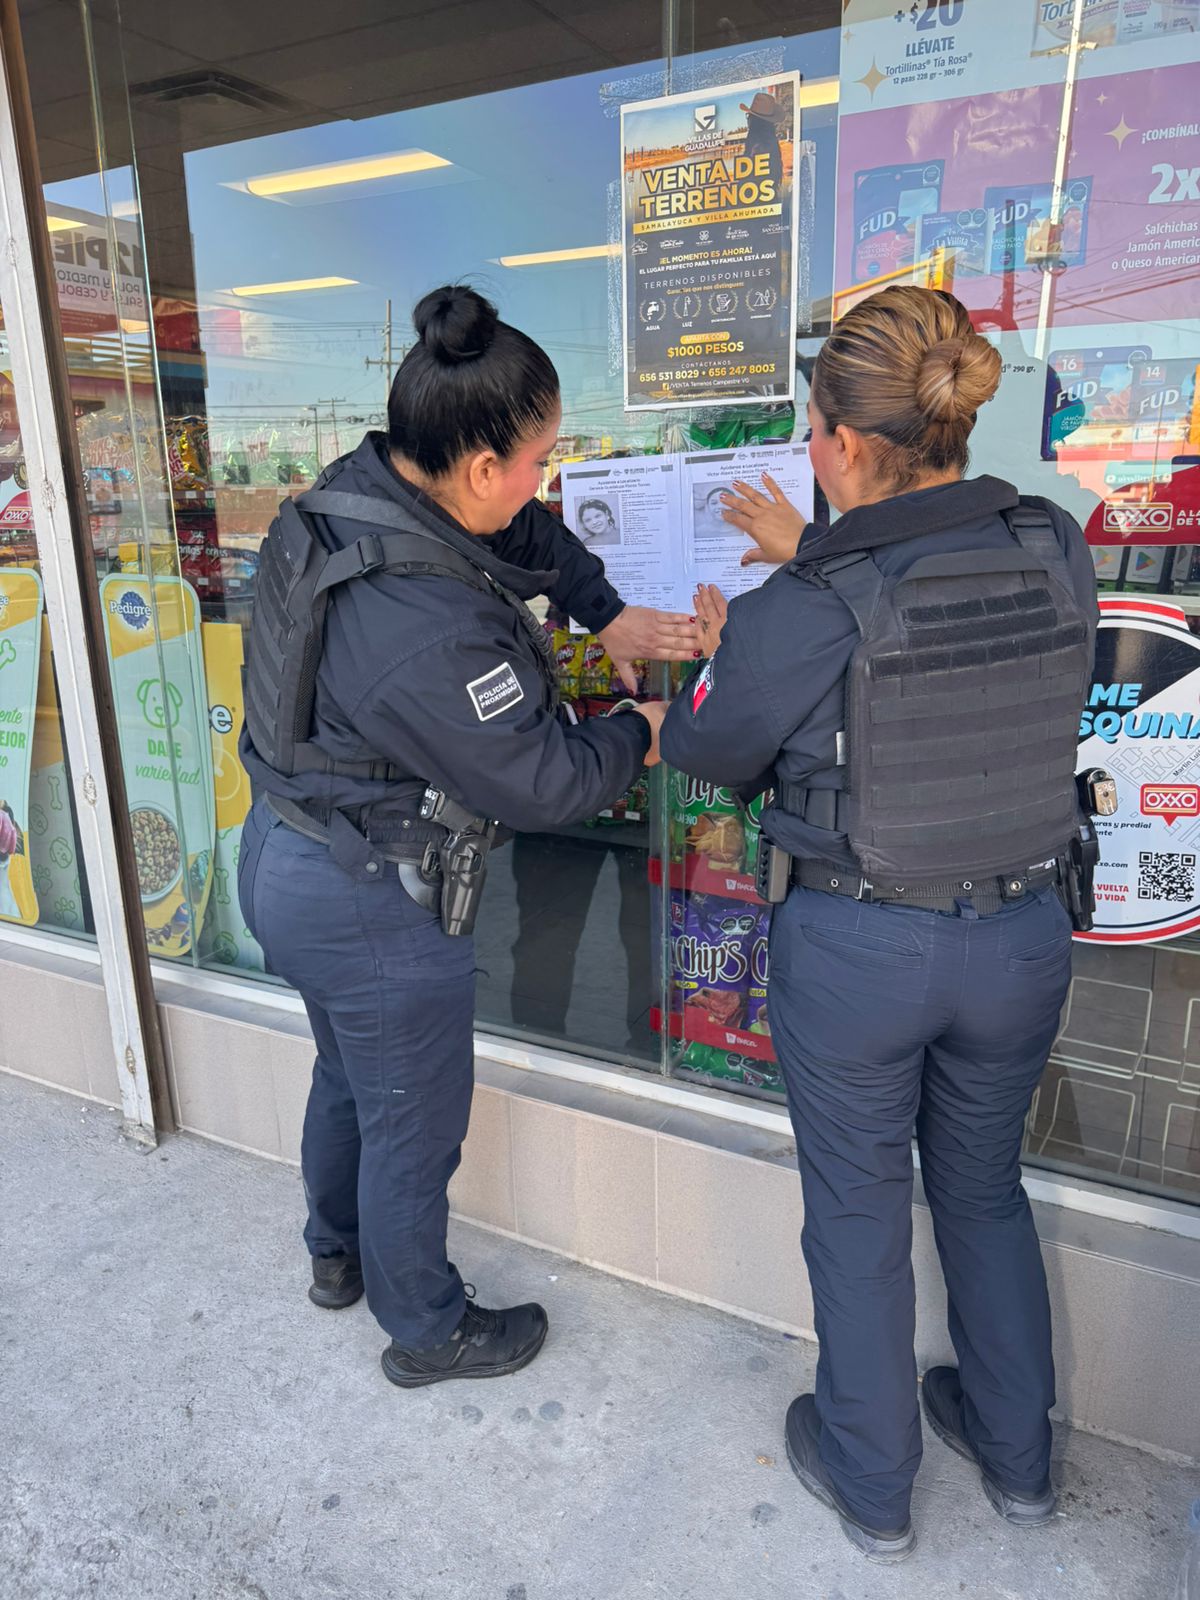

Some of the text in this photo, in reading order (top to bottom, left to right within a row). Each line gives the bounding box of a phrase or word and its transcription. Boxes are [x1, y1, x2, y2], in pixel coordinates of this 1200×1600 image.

[906, 36, 955, 57] LLÉVATE
[934, 57, 945, 68] Tía
[1141, 124, 1200, 144] ¡COMBÍNAL
[685, 140, 725, 152] GUADALUPE
[644, 153, 770, 192] VENTA DE
[641, 180, 776, 218] TERRENOS
[641, 218, 693, 231] SAMALAYUCA
[733, 208, 775, 218] AHUMADA
[860, 211, 896, 240] FUD
[1145, 222, 1198, 235] Salchichas
[672, 252, 709, 263] MOMENTO
[722, 247, 753, 257] AHORA!
[1127, 239, 1161, 253] Jamón
[647, 266, 665, 274] LUGAR
[666, 263, 694, 272] PERFECTO
[719, 256, 743, 264] FAMILIA
[744, 253, 759, 261] ESTÁ
[1112, 261, 1118, 270] o
[1121, 257, 1152, 271] Queso
[644, 268, 771, 289] TERRENOS DISPONIBLES
[667, 341, 744, 359] $1000 PESOS
[639, 363, 775, 382] 656 531 8029 656 247 8003
[1062, 358, 1077, 370] 16
[1146, 366, 1161, 378] 14
[1056, 381, 1097, 409] FUD
[1139, 389, 1179, 415] FUD
[4, 511, 28, 520] OXXO
[1107, 508, 1169, 526] OXXO
[1176, 518, 1193, 526] DE
[109, 601, 152, 616] Pedigre
[478, 682, 508, 702] POLICIA
[1085, 683, 1143, 706] ME
[1078, 711, 1200, 744] SQUINA
[148, 739, 182, 758] DAE
[135, 764, 200, 785] variead
[1173, 760, 1192, 777] Martin
[1146, 792, 1196, 808] OXXO
[1120, 821, 1152, 829] predial
[1097, 884, 1129, 892] VUELTA
[1105, 894, 1126, 902] VIDA
